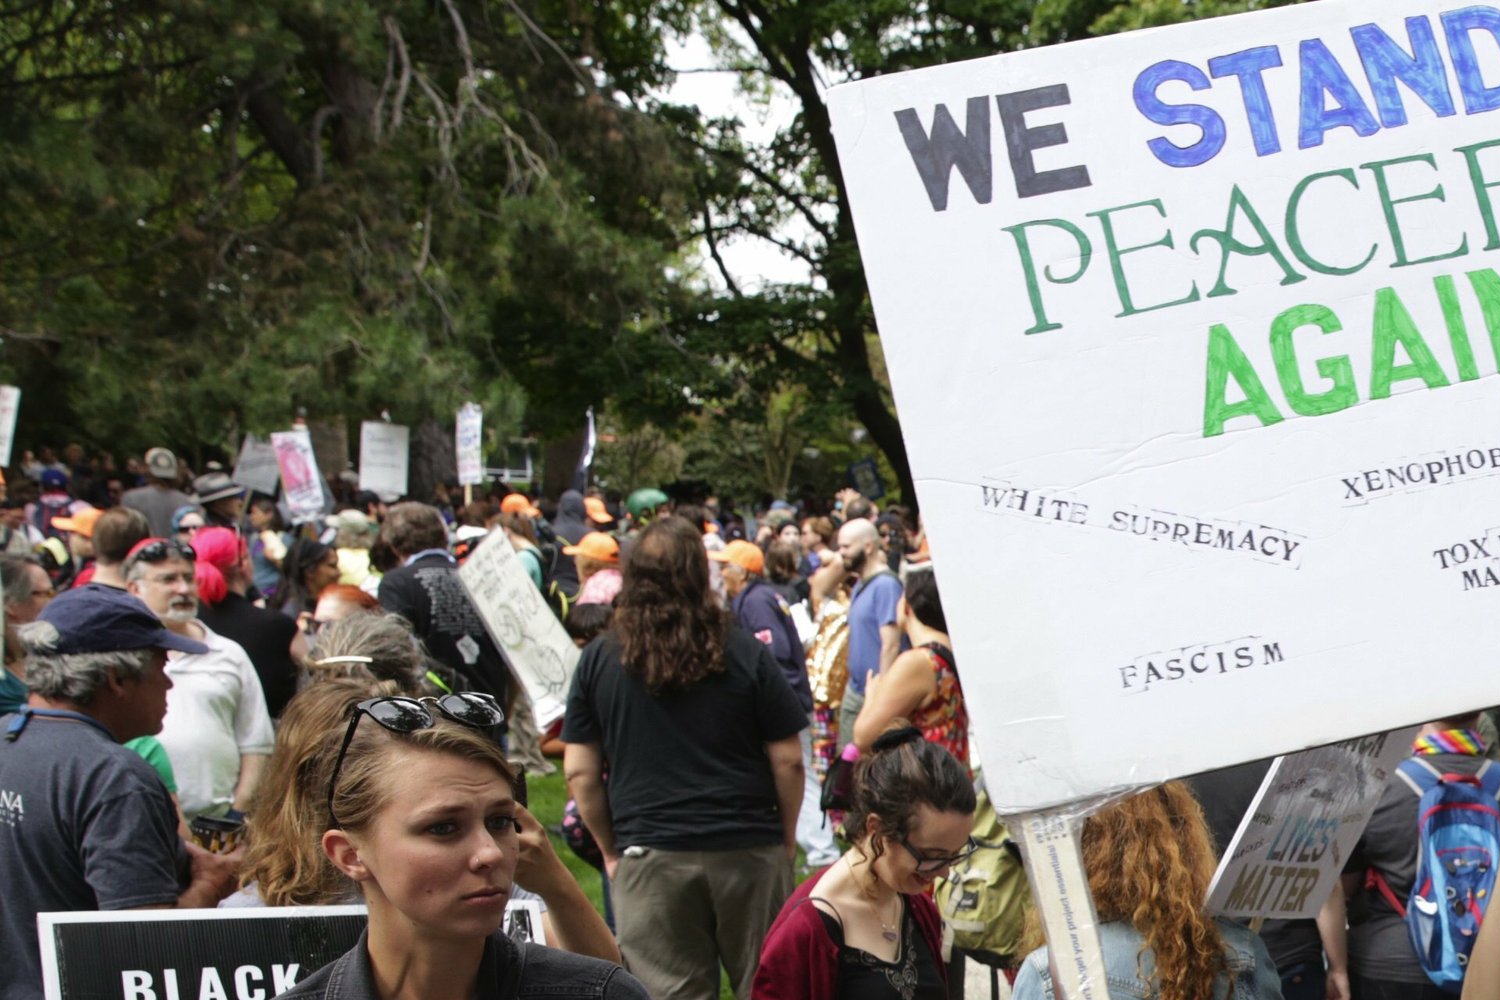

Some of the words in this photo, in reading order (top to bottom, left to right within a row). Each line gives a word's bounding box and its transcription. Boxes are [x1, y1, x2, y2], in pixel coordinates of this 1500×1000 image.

[896, 84, 1092, 212] WE
[981, 485, 1089, 526] WHITE
[1107, 510, 1300, 562] SUPREMACY
[1119, 641, 1285, 689] FASCISM
[1265, 814, 1340, 863] LIVES
[1223, 863, 1321, 912] MATTER
